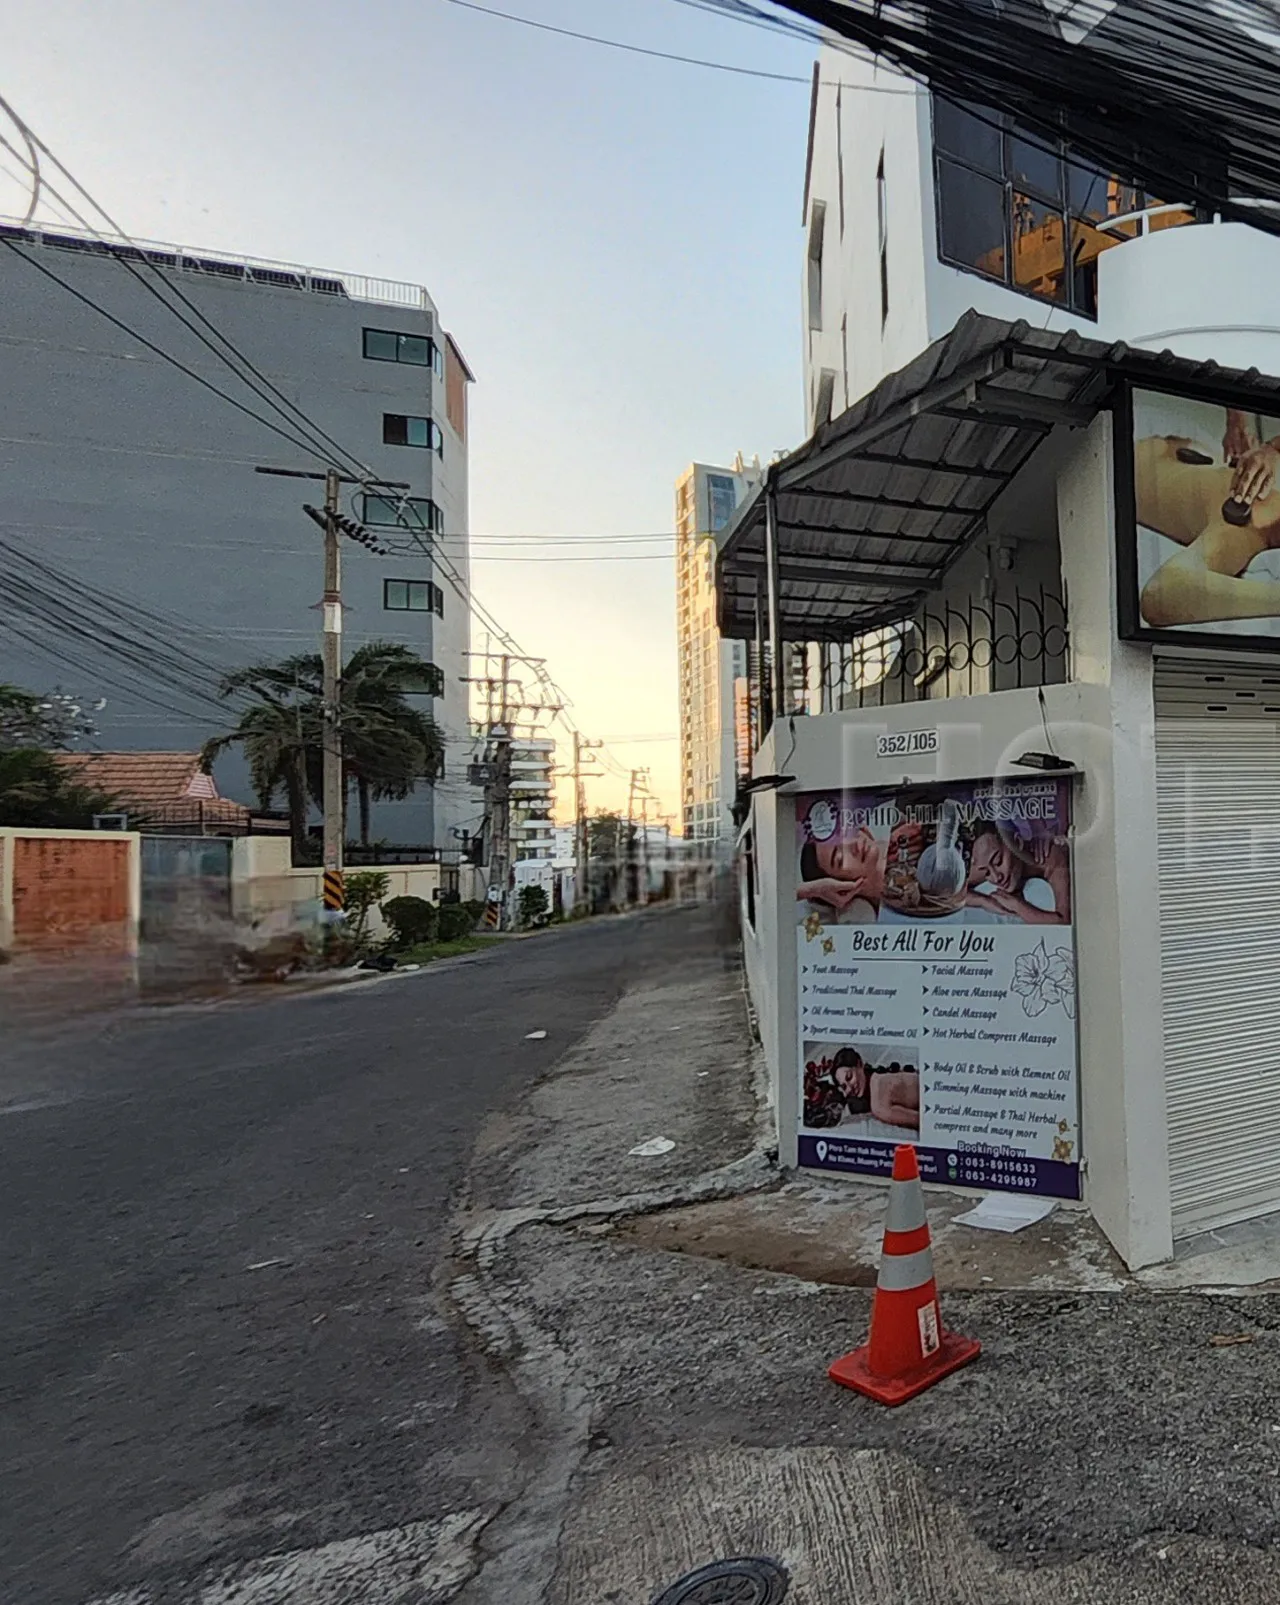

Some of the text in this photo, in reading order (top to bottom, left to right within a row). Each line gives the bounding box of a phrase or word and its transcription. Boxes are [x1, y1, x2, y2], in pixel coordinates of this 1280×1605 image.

[878, 732, 937, 754] 352/105
[955, 797, 1056, 823] MASSAGE
[852, 928, 995, 960] Best All For You
[828, 965, 859, 977] Massage
[931, 965, 993, 979] Facial Massage
[812, 984, 897, 999] Traditional Thai Massage
[931, 986, 1007, 1000] Aloe vera Massage
[811, 1006, 874, 1020] Oil Aroma Therapy
[932, 1006, 998, 1021] Candel Massage
[810, 1024, 828, 1036] Sport
[859, 1026, 875, 1036] with
[906, 1028, 918, 1039] Oil
[932, 1027, 1058, 1047] Hot Herbal Compress Massage
[933, 1061, 953, 1076] Body
[955, 1062, 967, 1074] Oil
[976, 1062, 999, 1075] Scrub
[1001, 1066, 1020, 1077] with
[1022, 1067, 1055, 1080] Element
[1057, 1069, 1071, 1081] Oil
[933, 1080, 1066, 1101] Slimming Massage with machine
[933, 1103, 961, 1116] Partial
[962, 1105, 999, 1120] Massage
[1008, 1109, 1027, 1121] Thai
[933, 1121, 1038, 1140] compress and many more
[958, 1141, 1027, 1159] Booking Now
